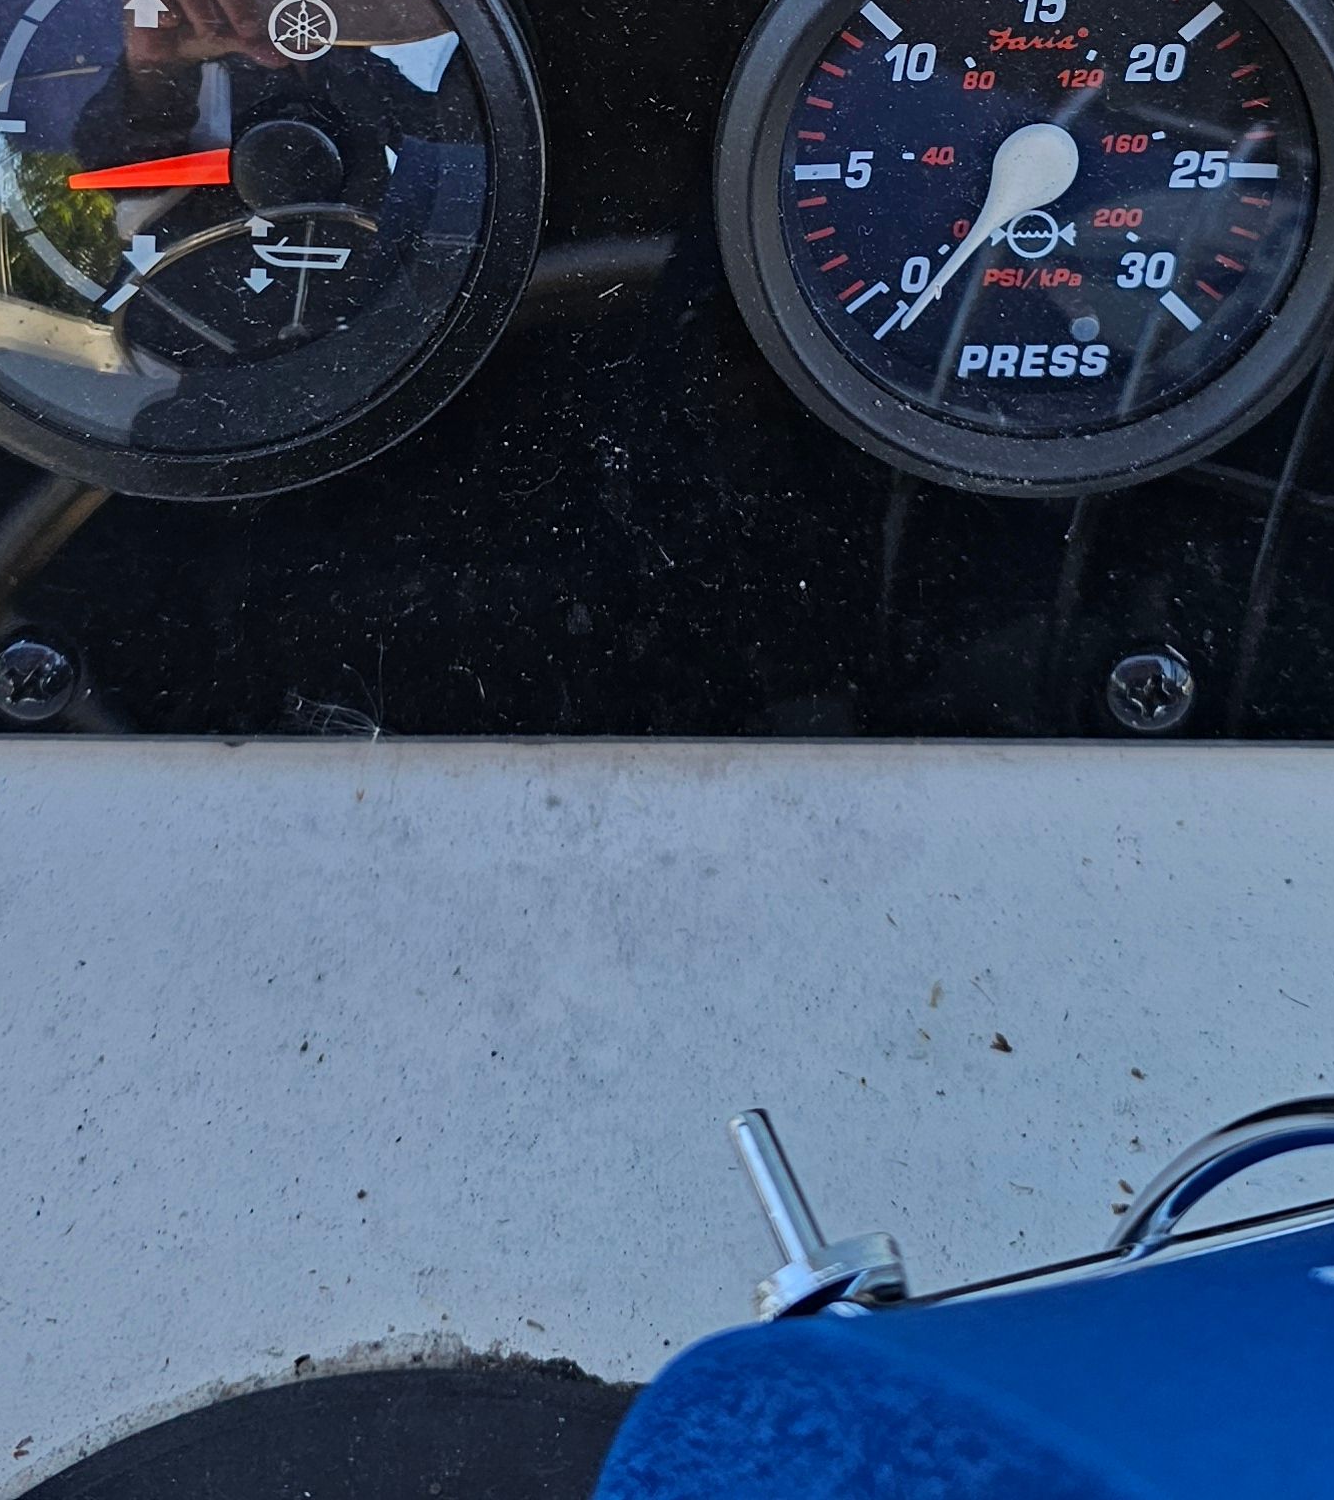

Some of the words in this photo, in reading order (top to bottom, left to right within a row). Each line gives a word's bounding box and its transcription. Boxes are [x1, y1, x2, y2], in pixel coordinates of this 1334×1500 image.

[884, 43, 937, 82] 10
[1057, 69, 1104, 88] 120
[1125, 43, 1186, 82] 20
[963, 71, 995, 90] 80
[921, 147, 954, 165] 40
[1101, 136, 1148, 154] 160
[845, 151, 873, 188] 5
[1169, 151, 1228, 188] 25
[953, 219, 970, 238] 0
[1093, 208, 1142, 227] 200
[900, 256, 930, 293] 0
[1117, 252, 1175, 288] 30
[958, 345, 1110, 377] PRESS
